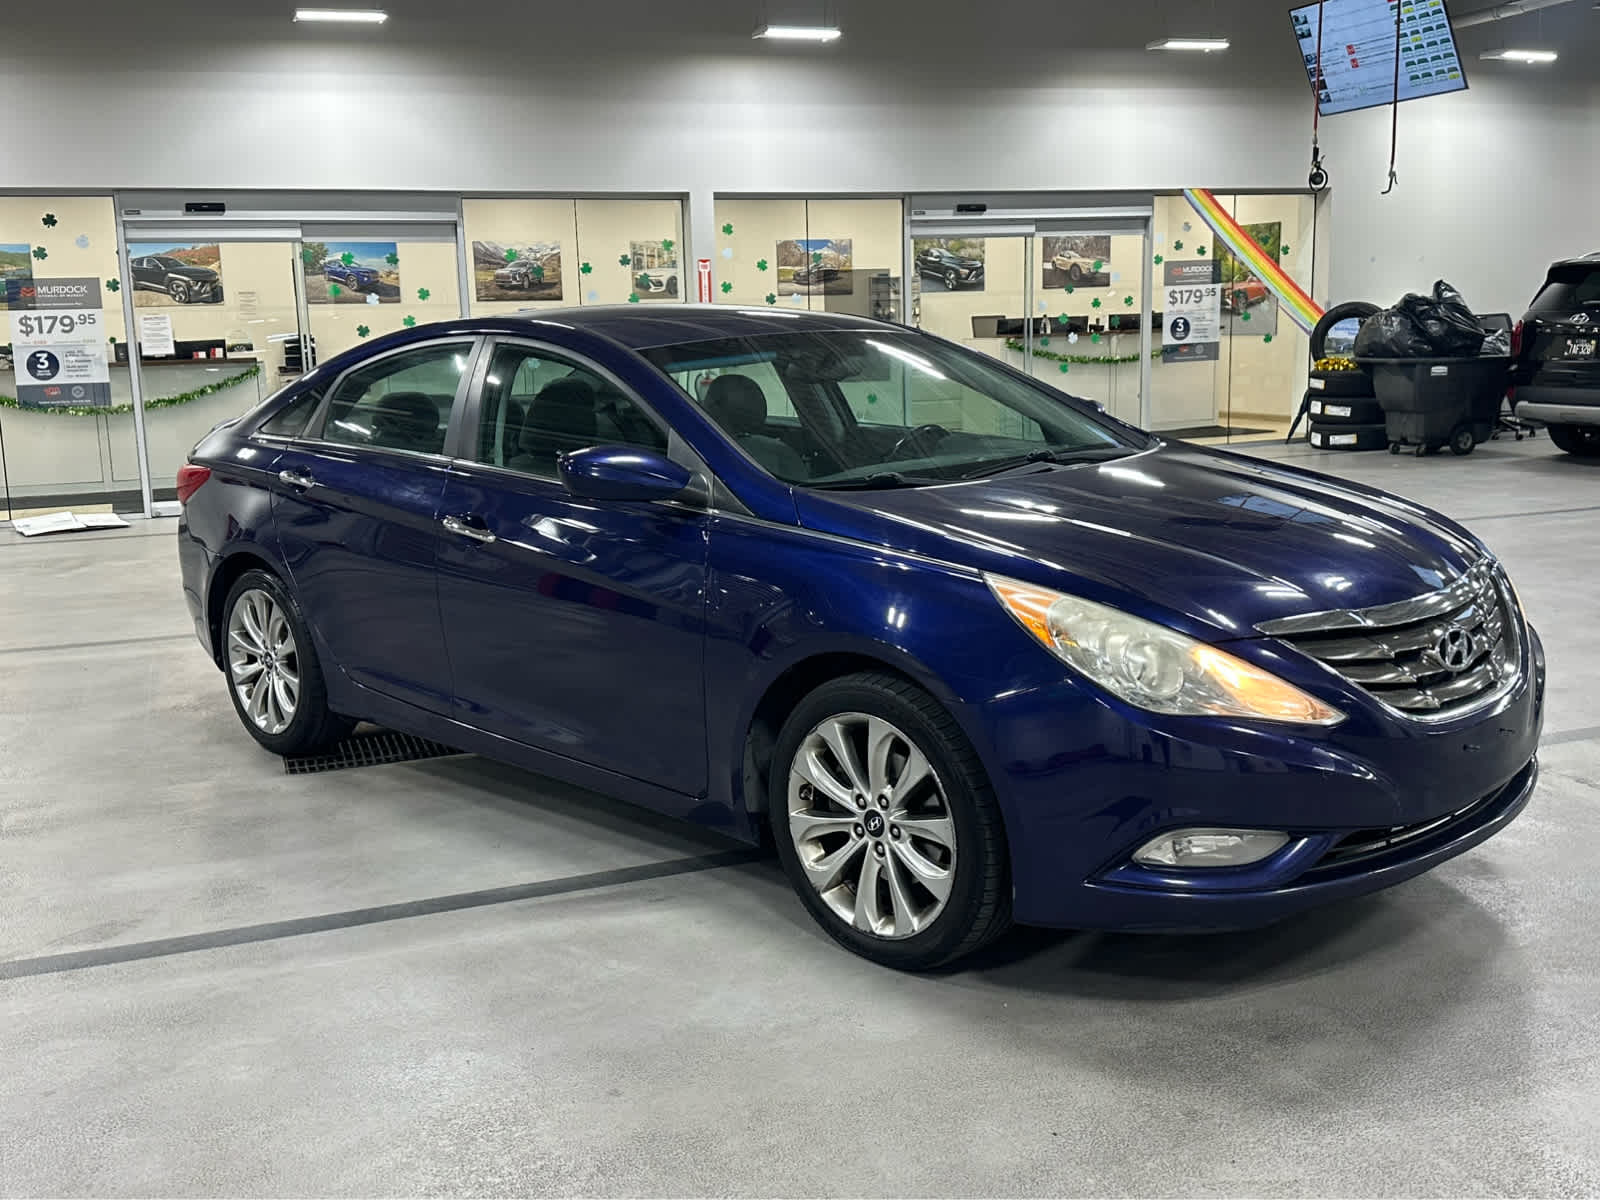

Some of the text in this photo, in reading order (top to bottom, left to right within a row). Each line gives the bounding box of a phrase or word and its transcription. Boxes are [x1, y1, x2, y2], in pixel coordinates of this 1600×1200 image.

[37, 285, 88, 294] MURDOCK
[1176, 318, 1185, 332] 3
[35, 353, 49, 369] 3
